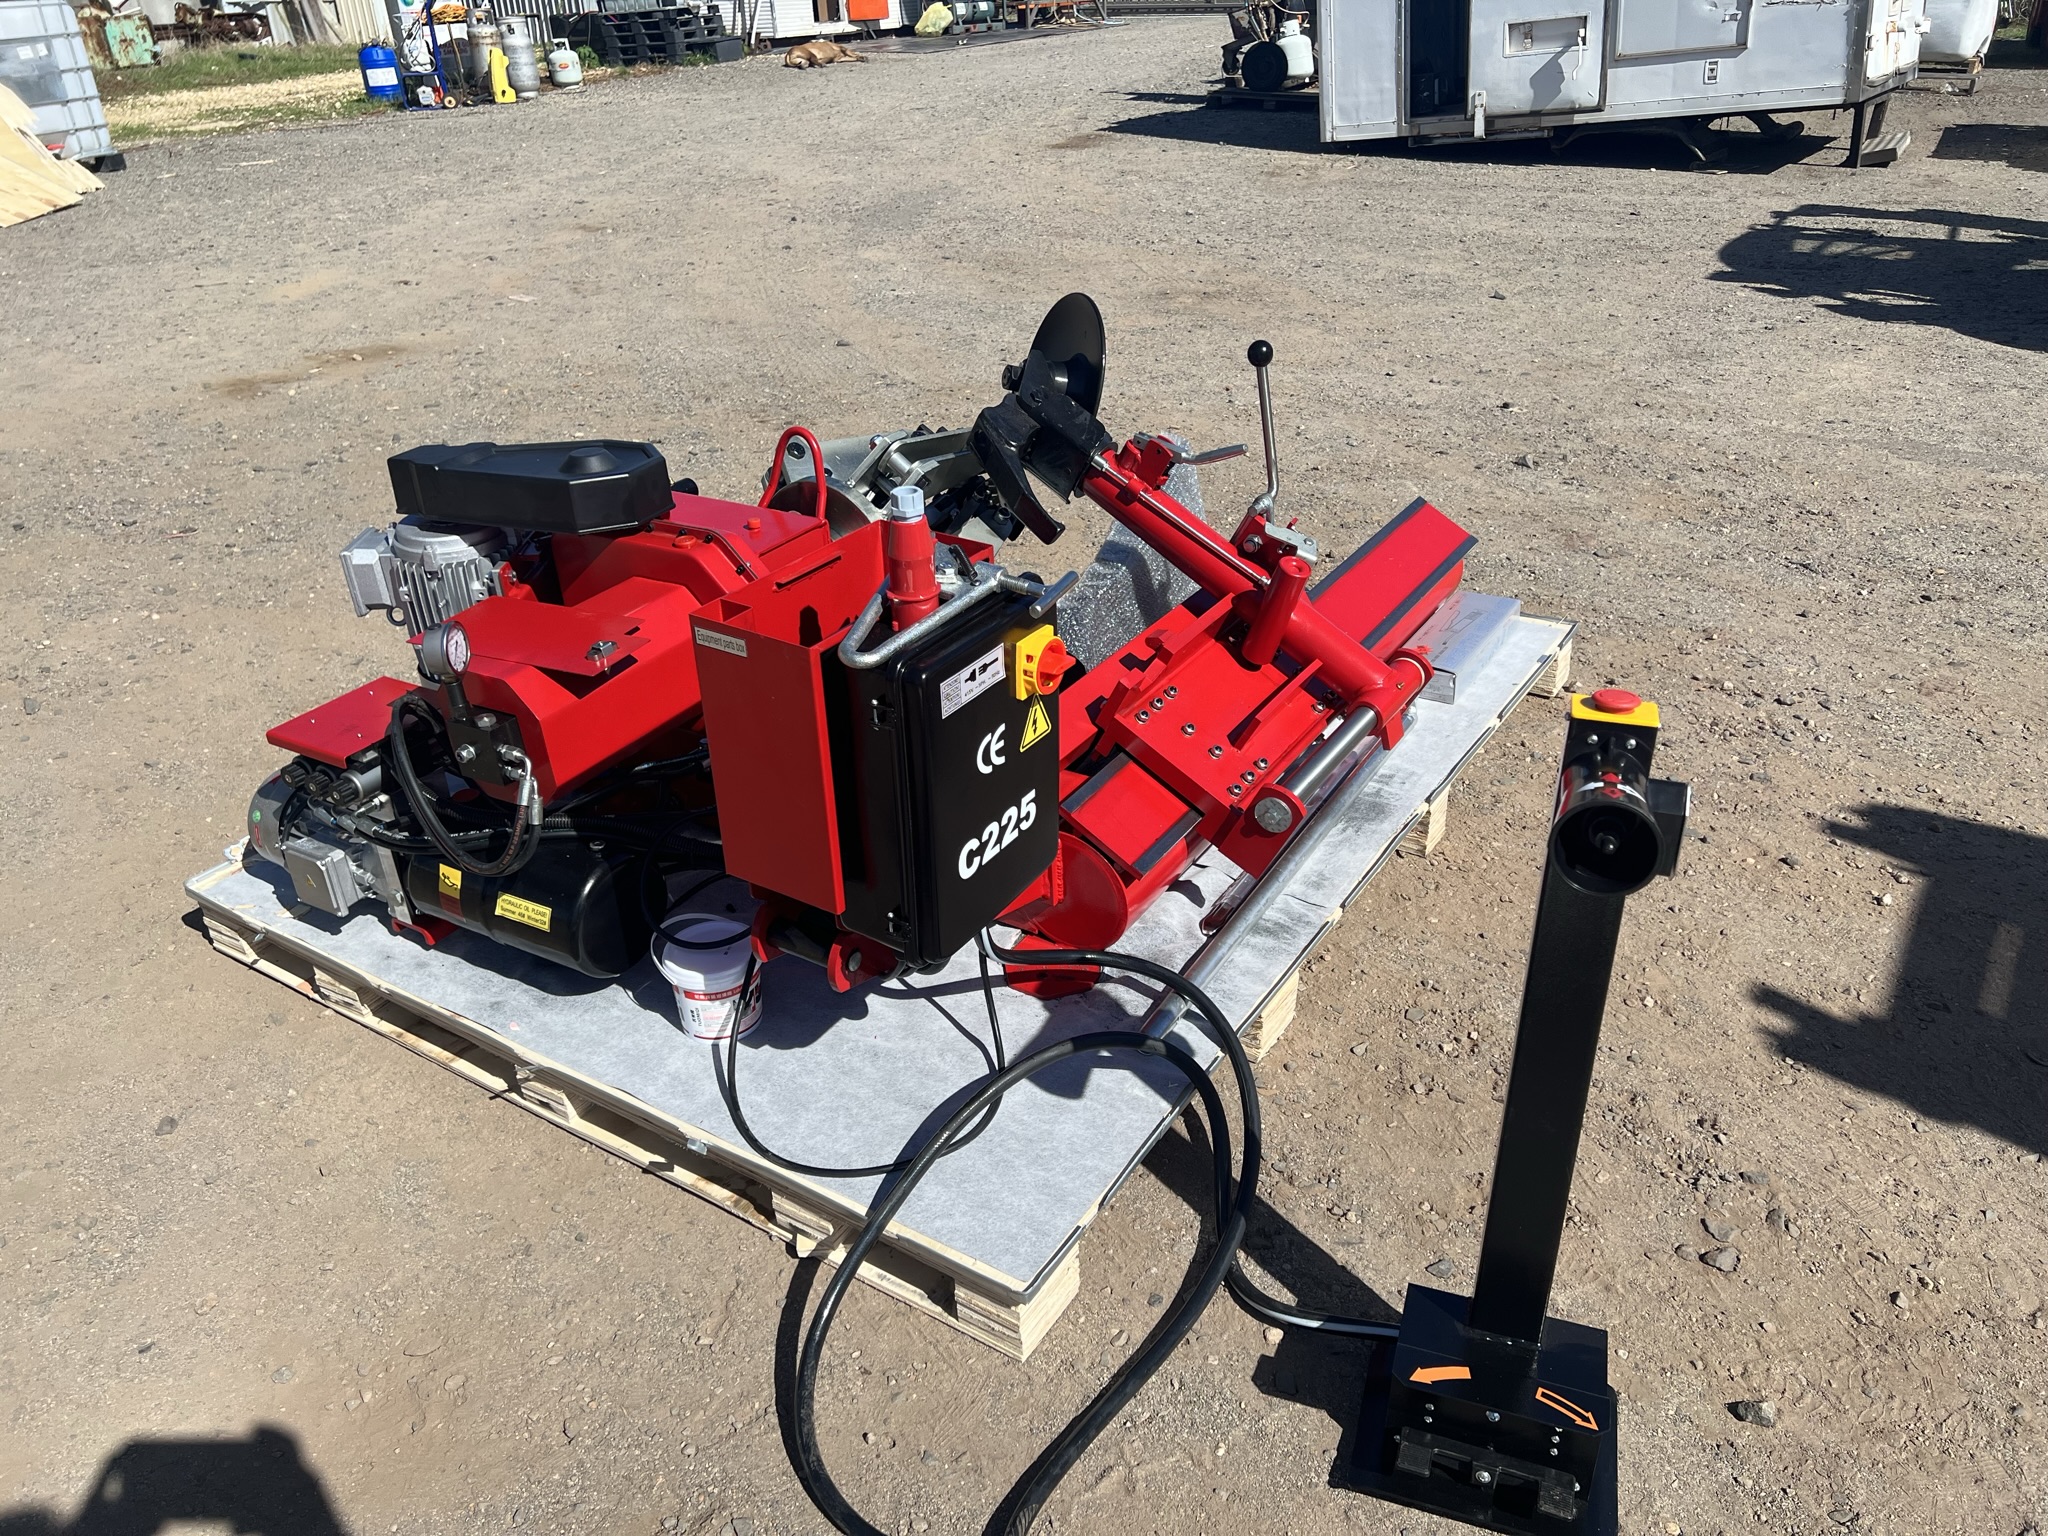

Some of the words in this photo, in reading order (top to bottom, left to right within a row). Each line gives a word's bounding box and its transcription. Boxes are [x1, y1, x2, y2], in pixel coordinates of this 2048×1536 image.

[723, 639, 736, 651] parts
[976, 723, 1005, 774] CE
[958, 789, 1037, 880] C225
[500, 905, 516, 915] Summer
[501, 898, 523, 910] HYDRAULIC
